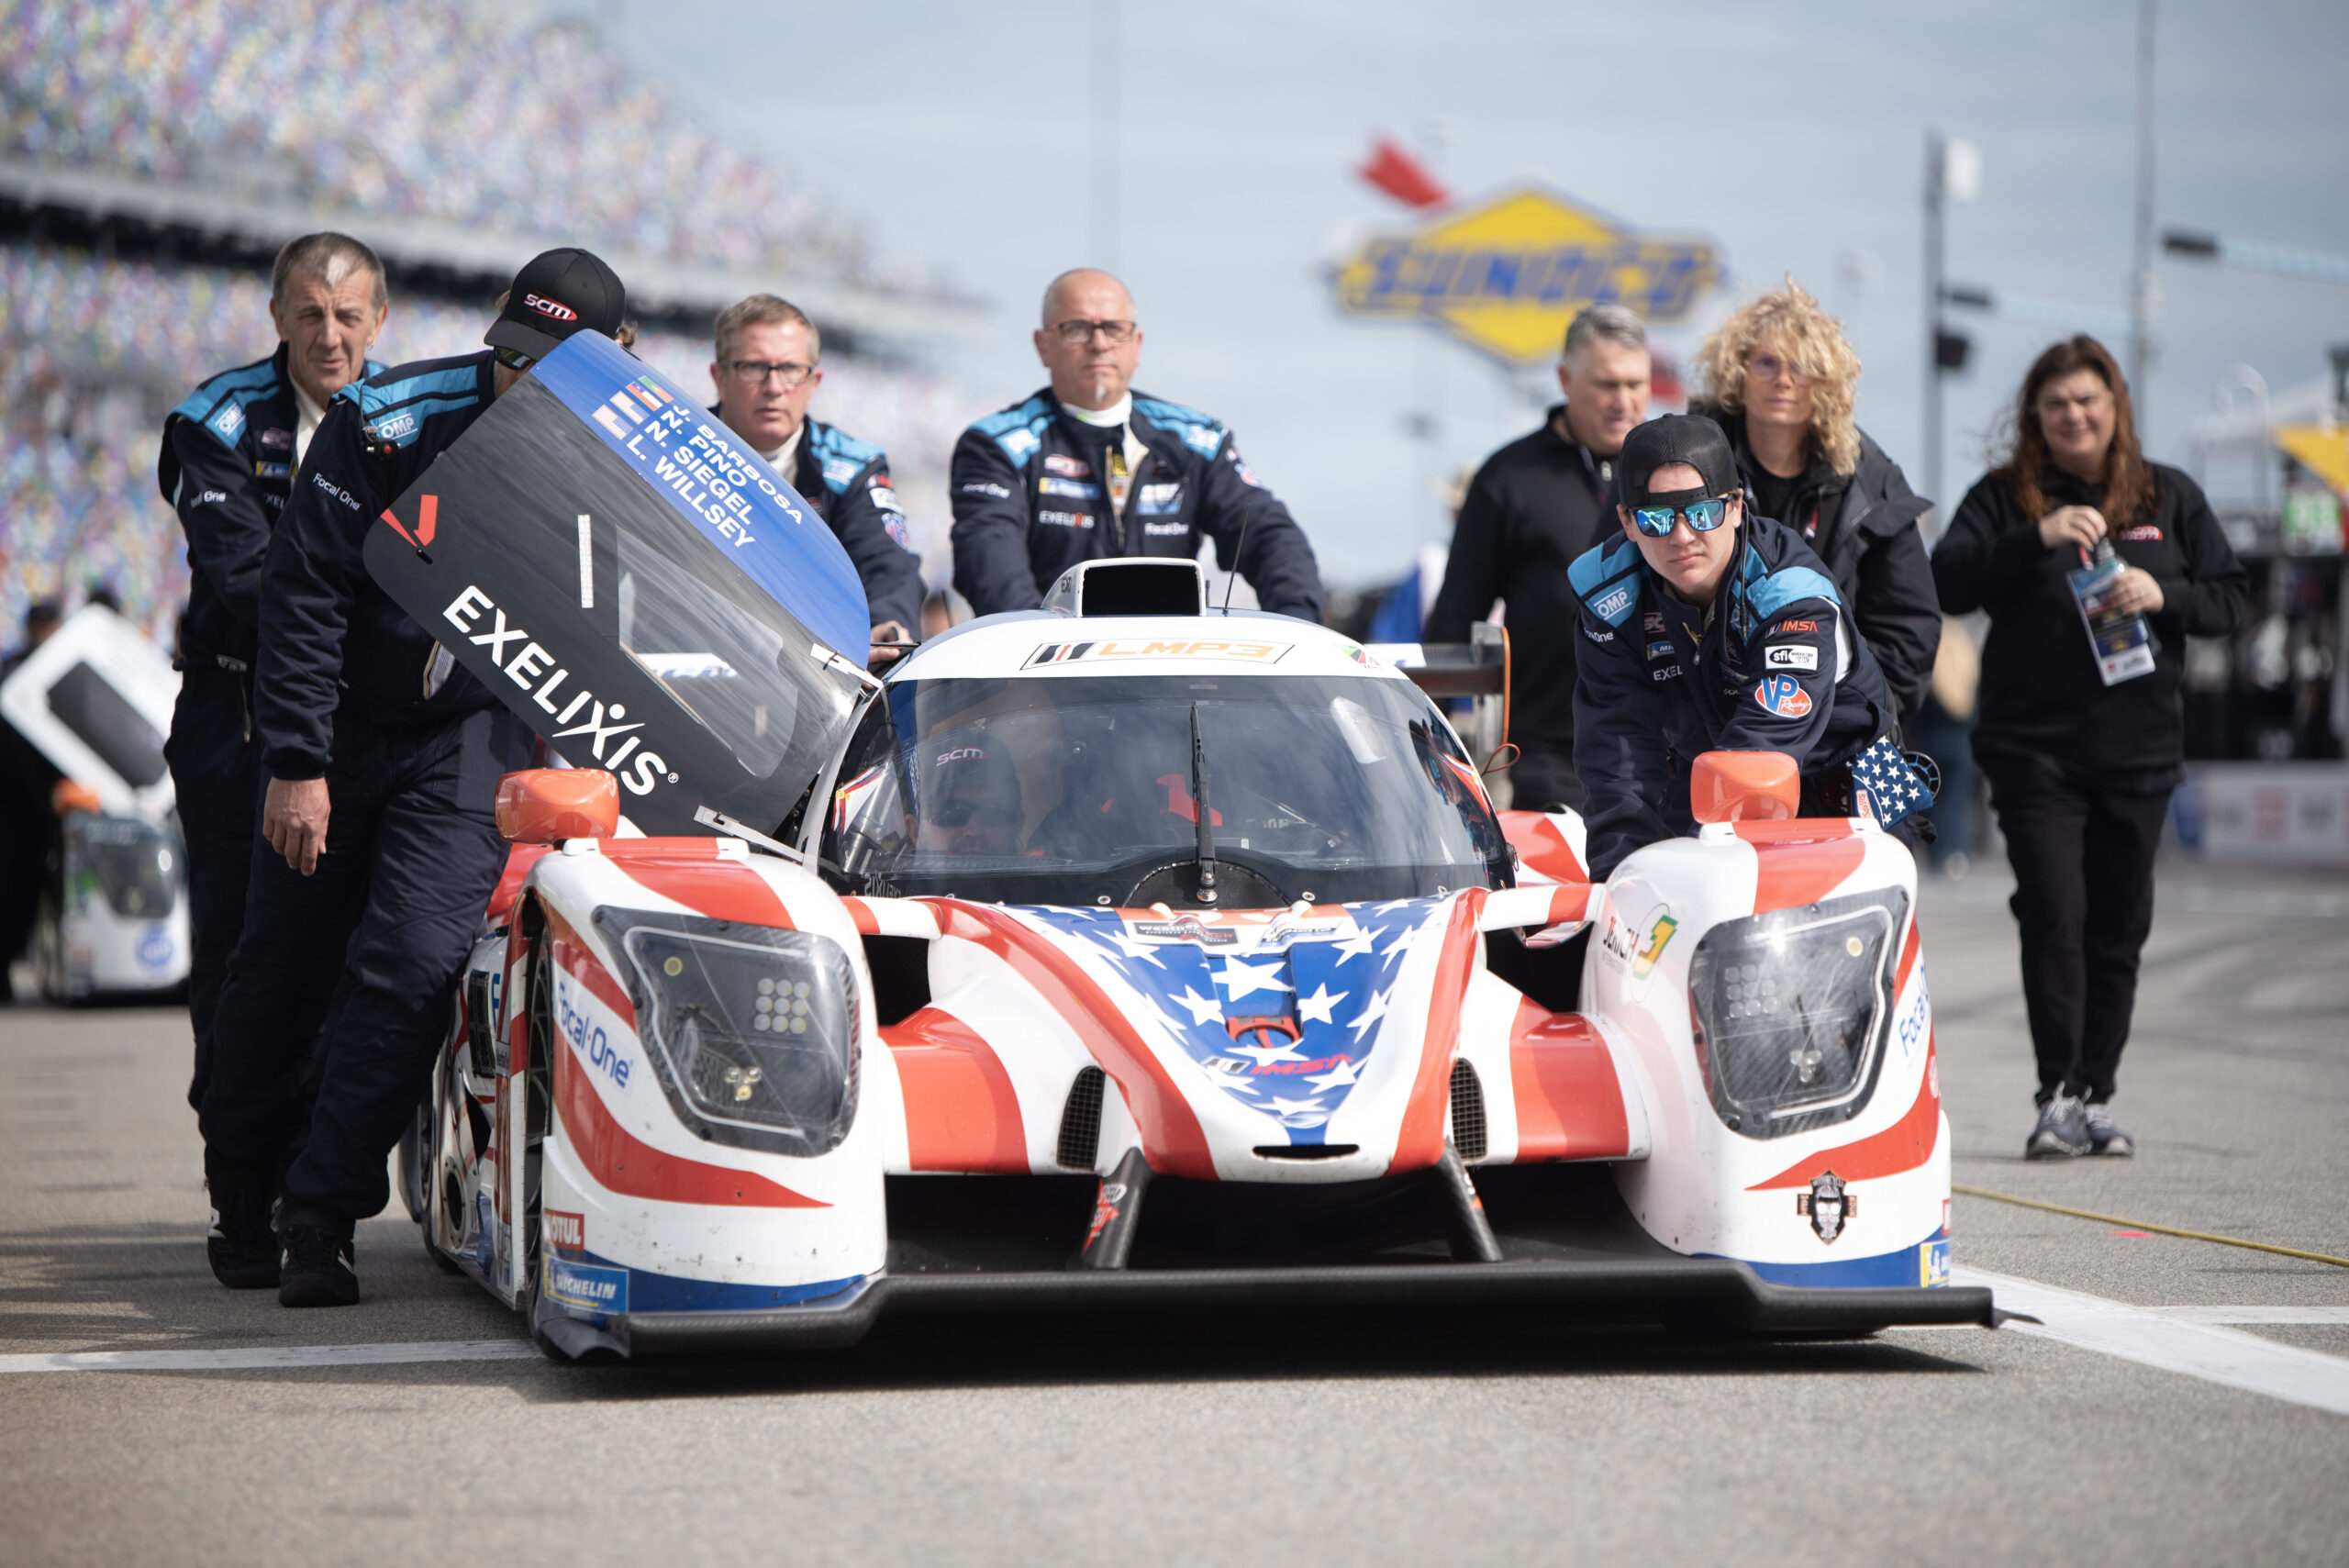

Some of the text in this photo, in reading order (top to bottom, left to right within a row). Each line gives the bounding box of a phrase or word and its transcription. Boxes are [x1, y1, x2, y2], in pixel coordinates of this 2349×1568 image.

[382, 417, 414, 439] OMP
[661, 410, 748, 487] N. PINO
[644, 421, 756, 525] N. SIEGEL
[674, 406, 691, 422] J.
[697, 425, 803, 525] BARBOSA
[204, 490, 226, 503] One
[313, 473, 360, 512] Focal One
[626, 434, 647, 461] L.
[654, 455, 757, 548] WILLSEY
[1597, 591, 1629, 617] OMP
[1781, 620, 1820, 634] IMSA
[1097, 642, 1275, 659] LMP3
[1773, 651, 1788, 662] sfi
[1762, 674, 1799, 713] VP
[1780, 698, 1811, 713] Racing
[589, 1025, 630, 1089] One
[1249, 1052, 1353, 1075] IMSA
